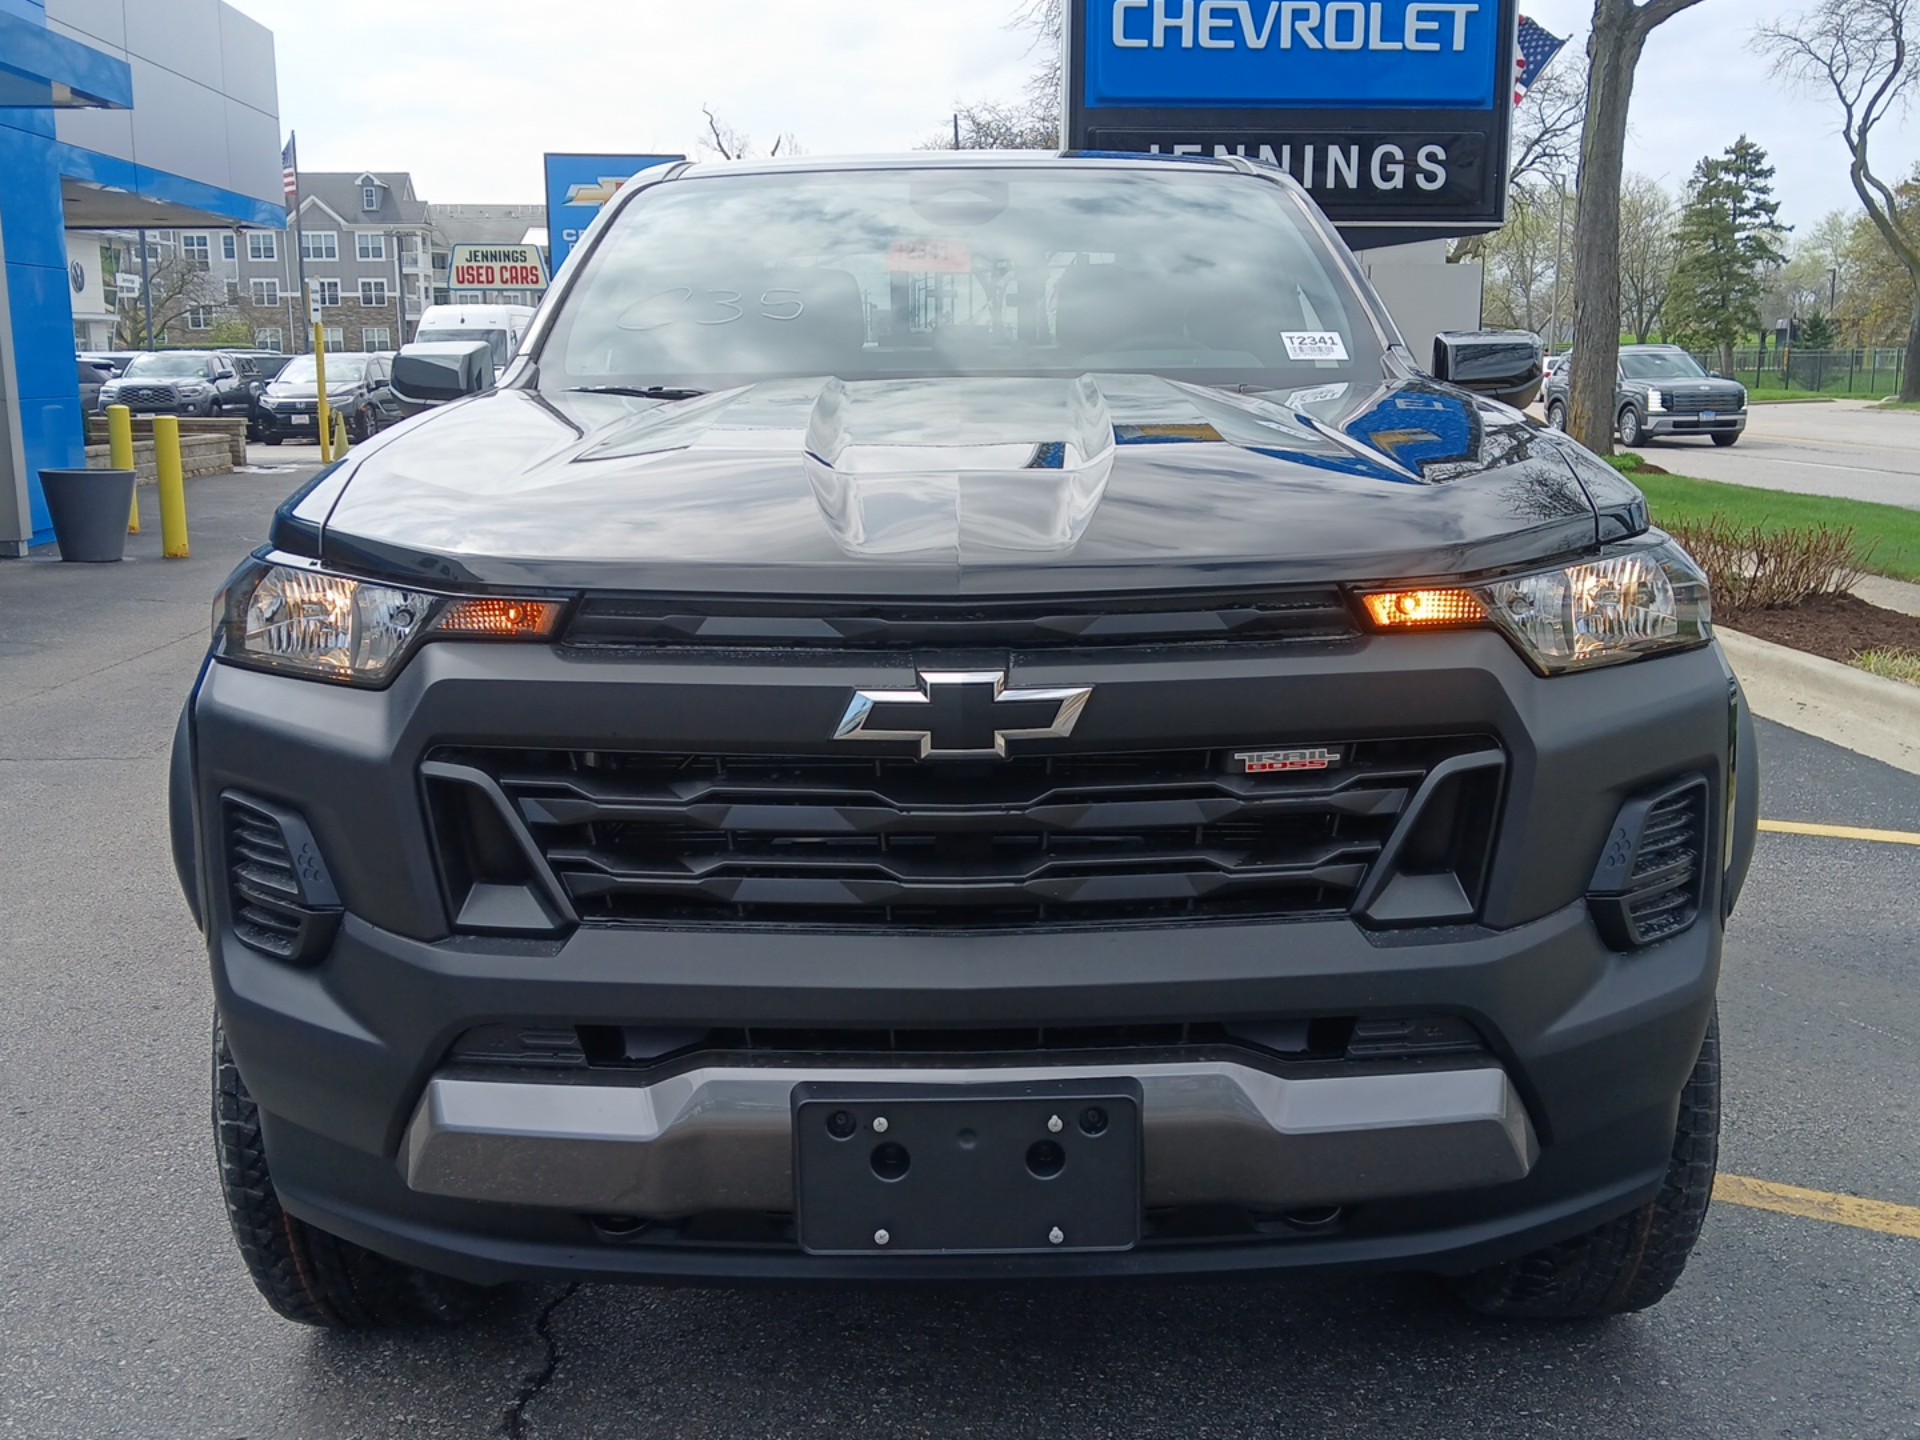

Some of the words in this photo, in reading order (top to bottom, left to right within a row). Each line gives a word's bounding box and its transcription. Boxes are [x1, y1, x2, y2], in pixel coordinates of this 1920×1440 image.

[1112, 0, 1479, 50] CHEVROLET
[1150, 144, 1447, 190] NINGS
[465, 250, 527, 263] JENNINGS
[455, 265, 495, 284] USED
[500, 265, 539, 284] CARS
[1285, 335, 1338, 346] T2341
[1235, 749, 1340, 763] TRAIL
